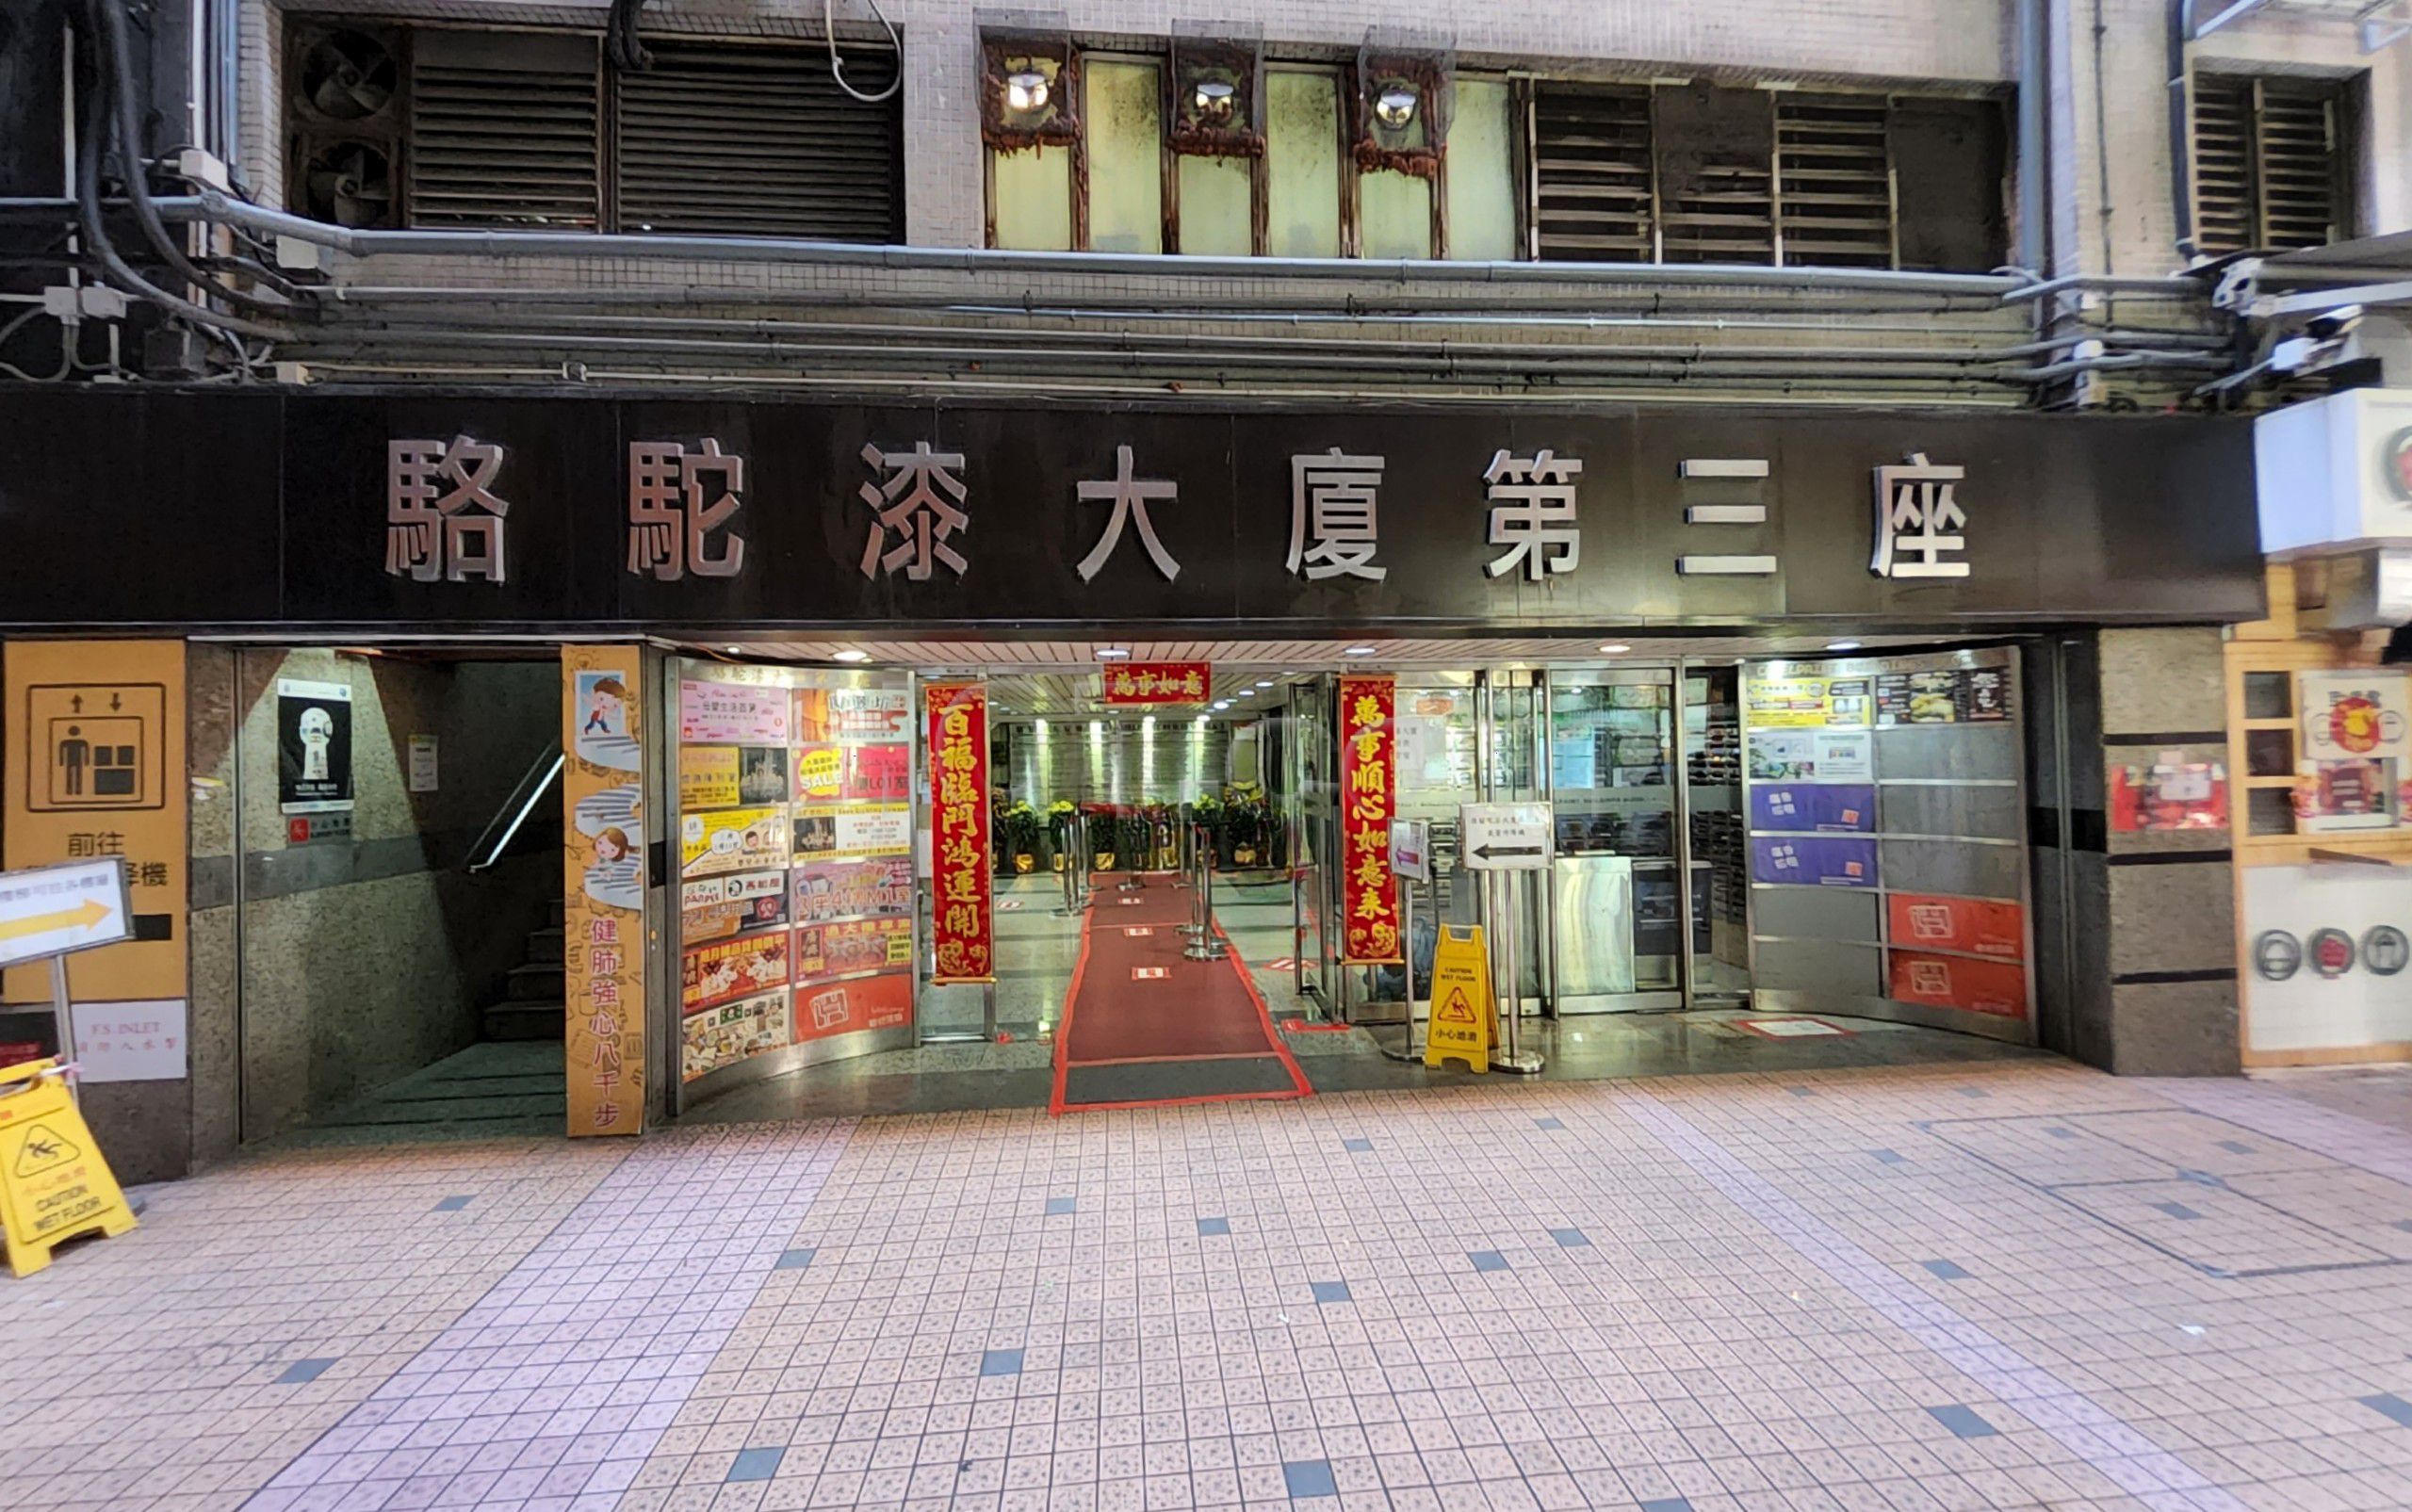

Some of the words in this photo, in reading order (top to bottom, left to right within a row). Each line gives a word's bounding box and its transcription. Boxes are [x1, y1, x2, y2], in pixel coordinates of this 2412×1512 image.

[384, 435, 1972, 584] 駱駝漆大廈第三座
[1112, 670, 1204, 696] 萬事如意
[801, 772, 844, 789] SALE
[937, 703, 981, 939] 百福臨門鴻運開
[1348, 694, 1390, 920] 萬事順心如意來
[67, 831, 125, 856] 前往
[589, 918, 620, 1128] 健肺強心八千步
[35, 1183, 89, 1212] CAUTION
